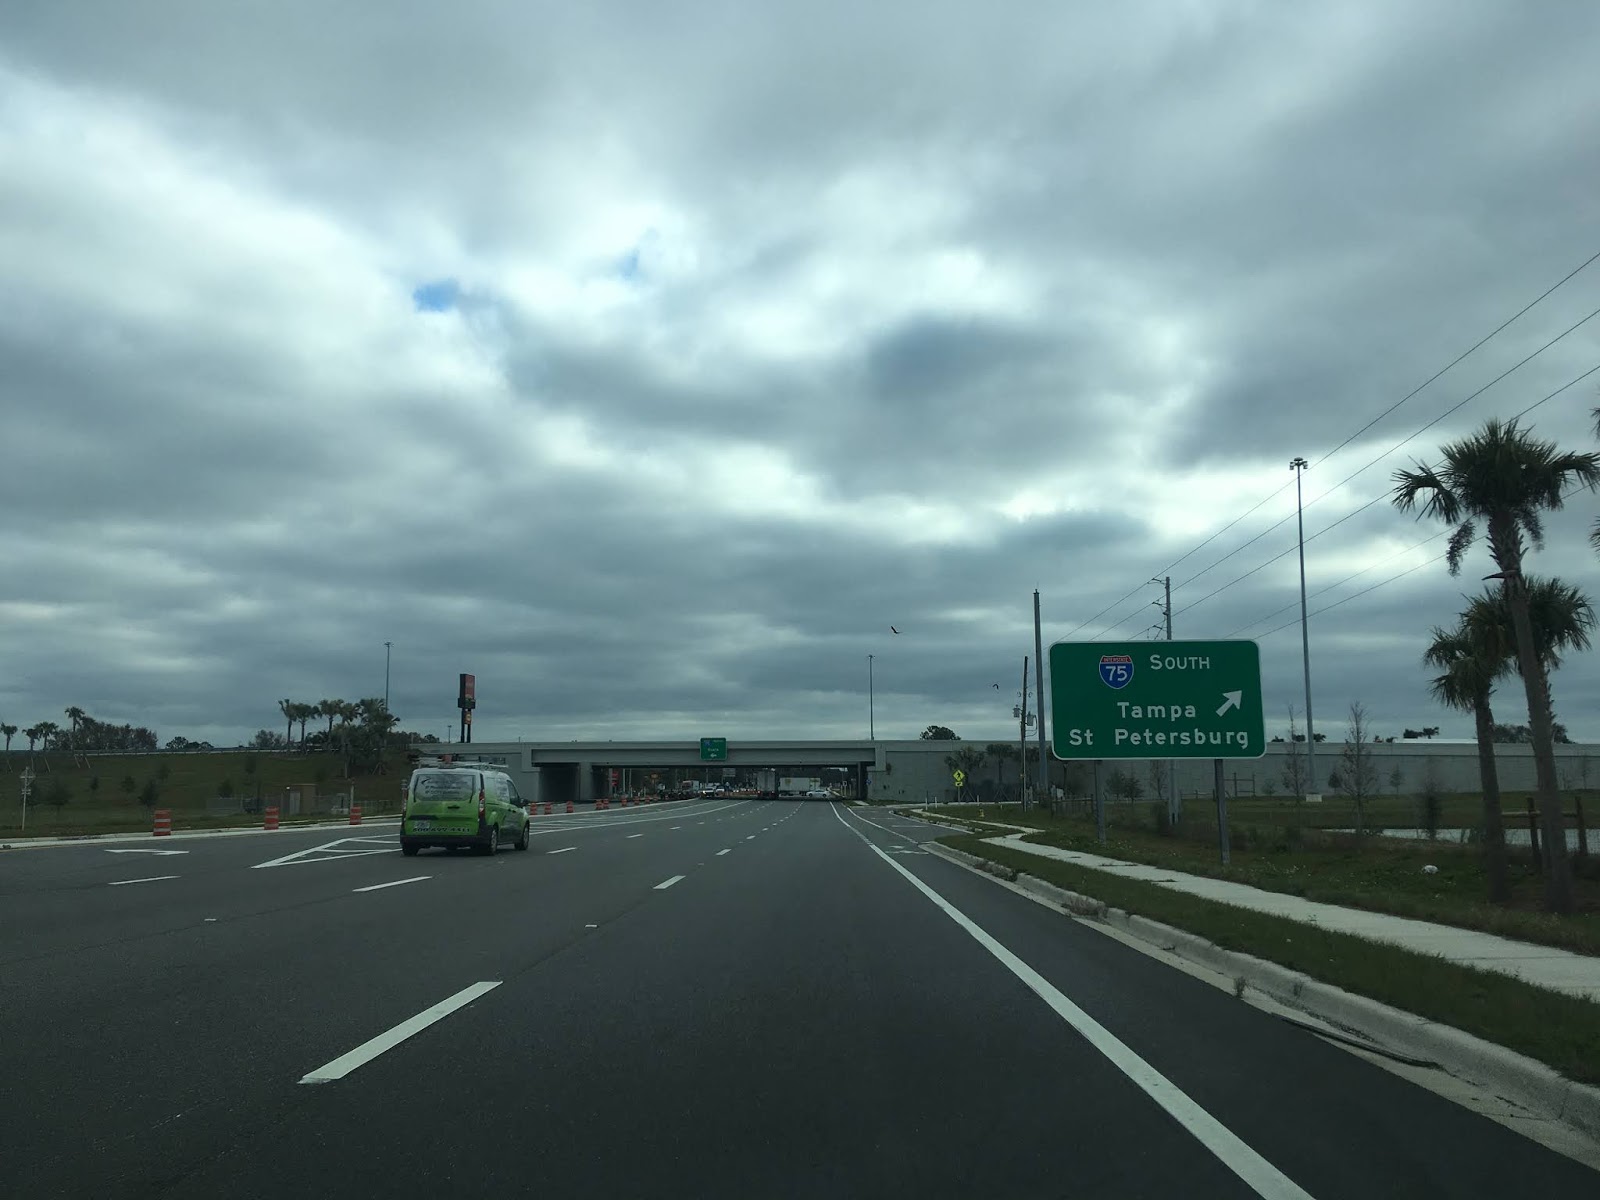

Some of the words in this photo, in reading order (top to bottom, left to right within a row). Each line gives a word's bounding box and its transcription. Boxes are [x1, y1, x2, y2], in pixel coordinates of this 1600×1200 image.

[1149, 654, 1210, 670] SOUTH
[1105, 665, 1128, 681] 75
[1117, 701, 1197, 722] Tampa
[1069, 728, 1094, 746] St
[1114, 728, 1249, 750] Petersburg
